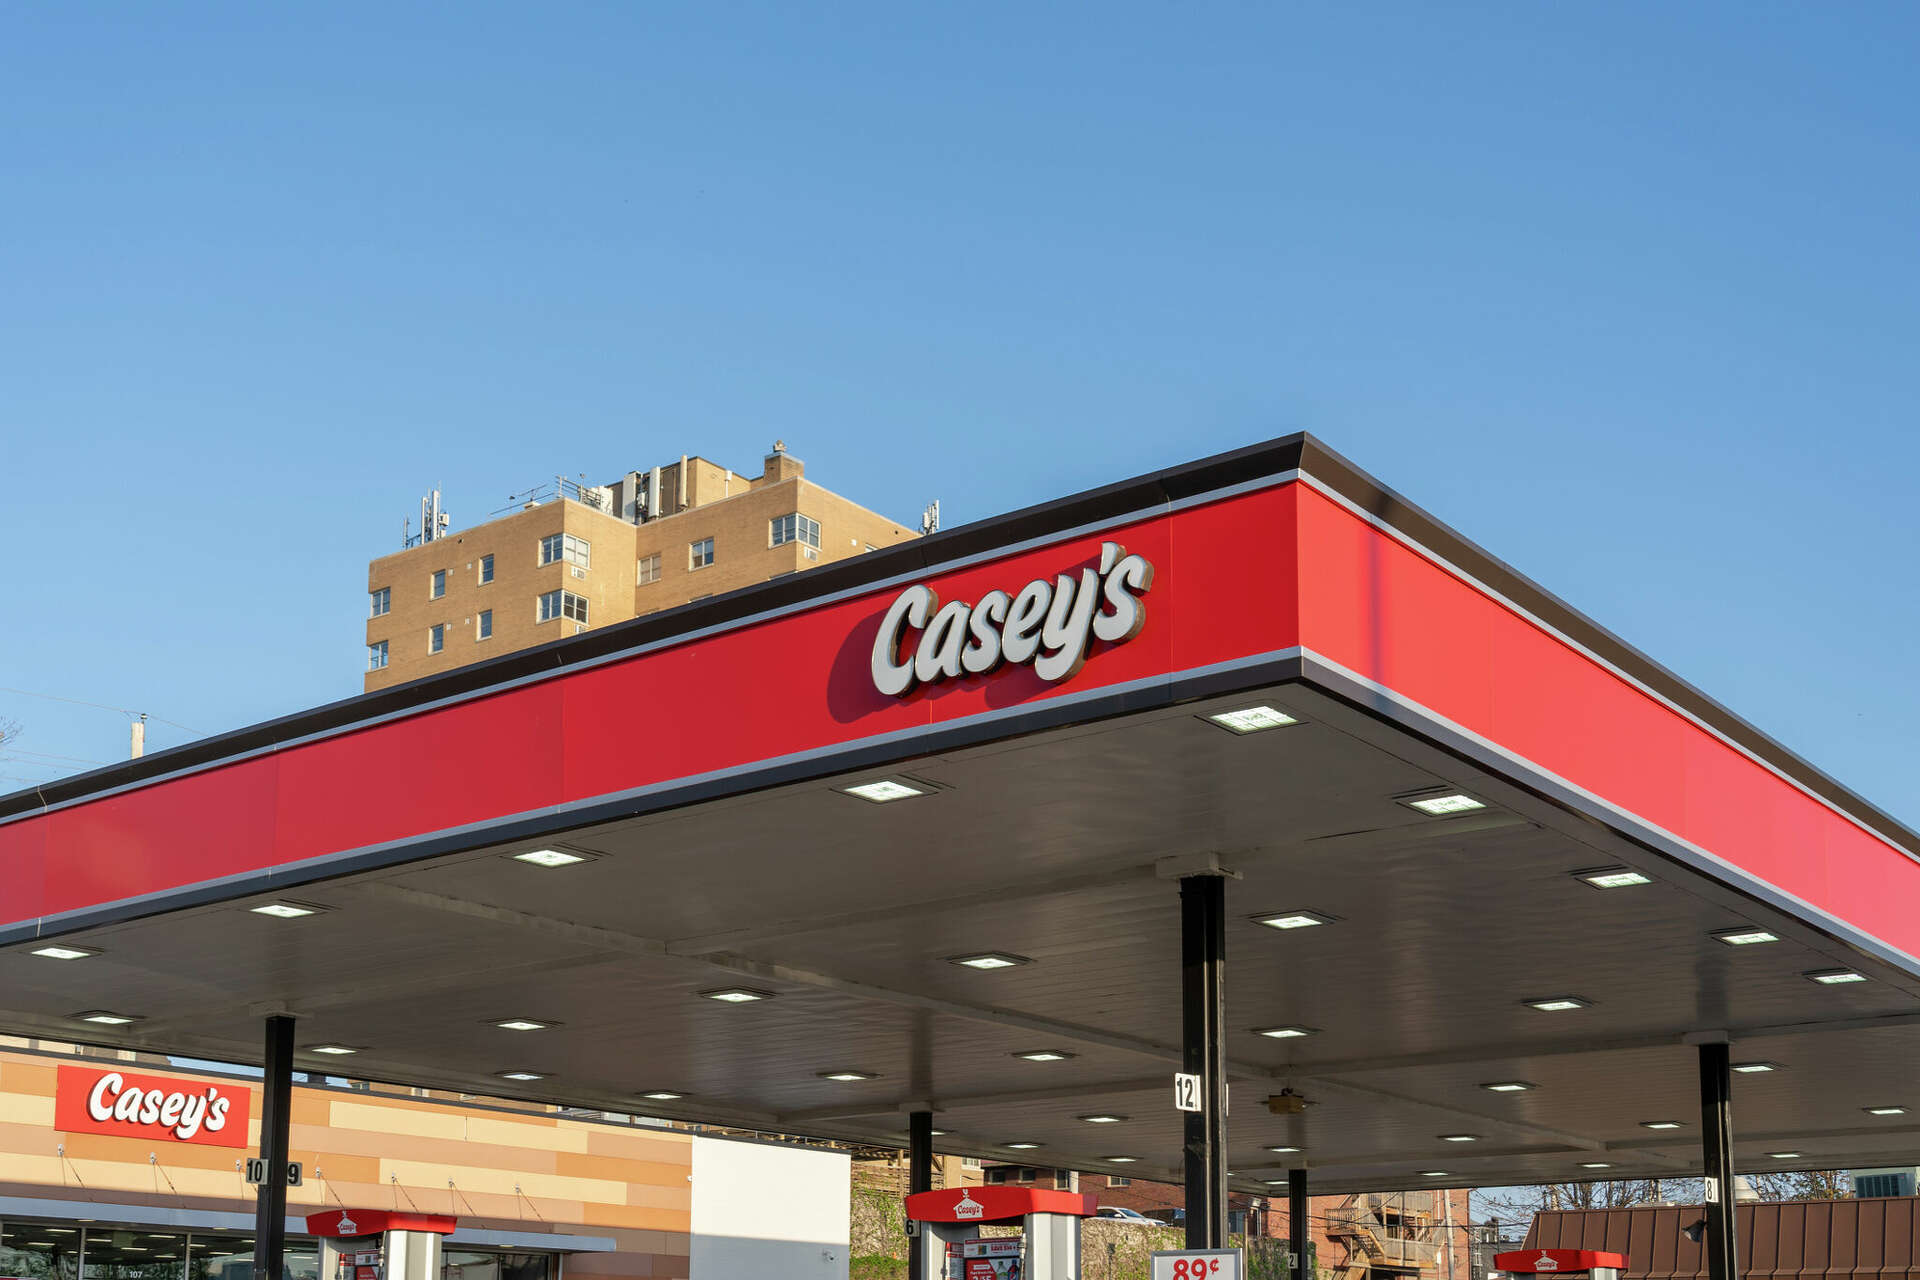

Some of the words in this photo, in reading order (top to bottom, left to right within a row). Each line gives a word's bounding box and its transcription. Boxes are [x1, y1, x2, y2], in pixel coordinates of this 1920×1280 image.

[871, 541, 1153, 696] Casey's
[1177, 1077, 1194, 1108] 12
[89, 1073, 231, 1140] Casey's
[247, 1160, 263, 1182] 10
[288, 1163, 299, 1185] 9
[1706, 1180, 1713, 1200] 8
[957, 1205, 981, 1216] Casey's
[906, 1219, 914, 1235] 6
[1289, 1254, 1295, 1267] 2
